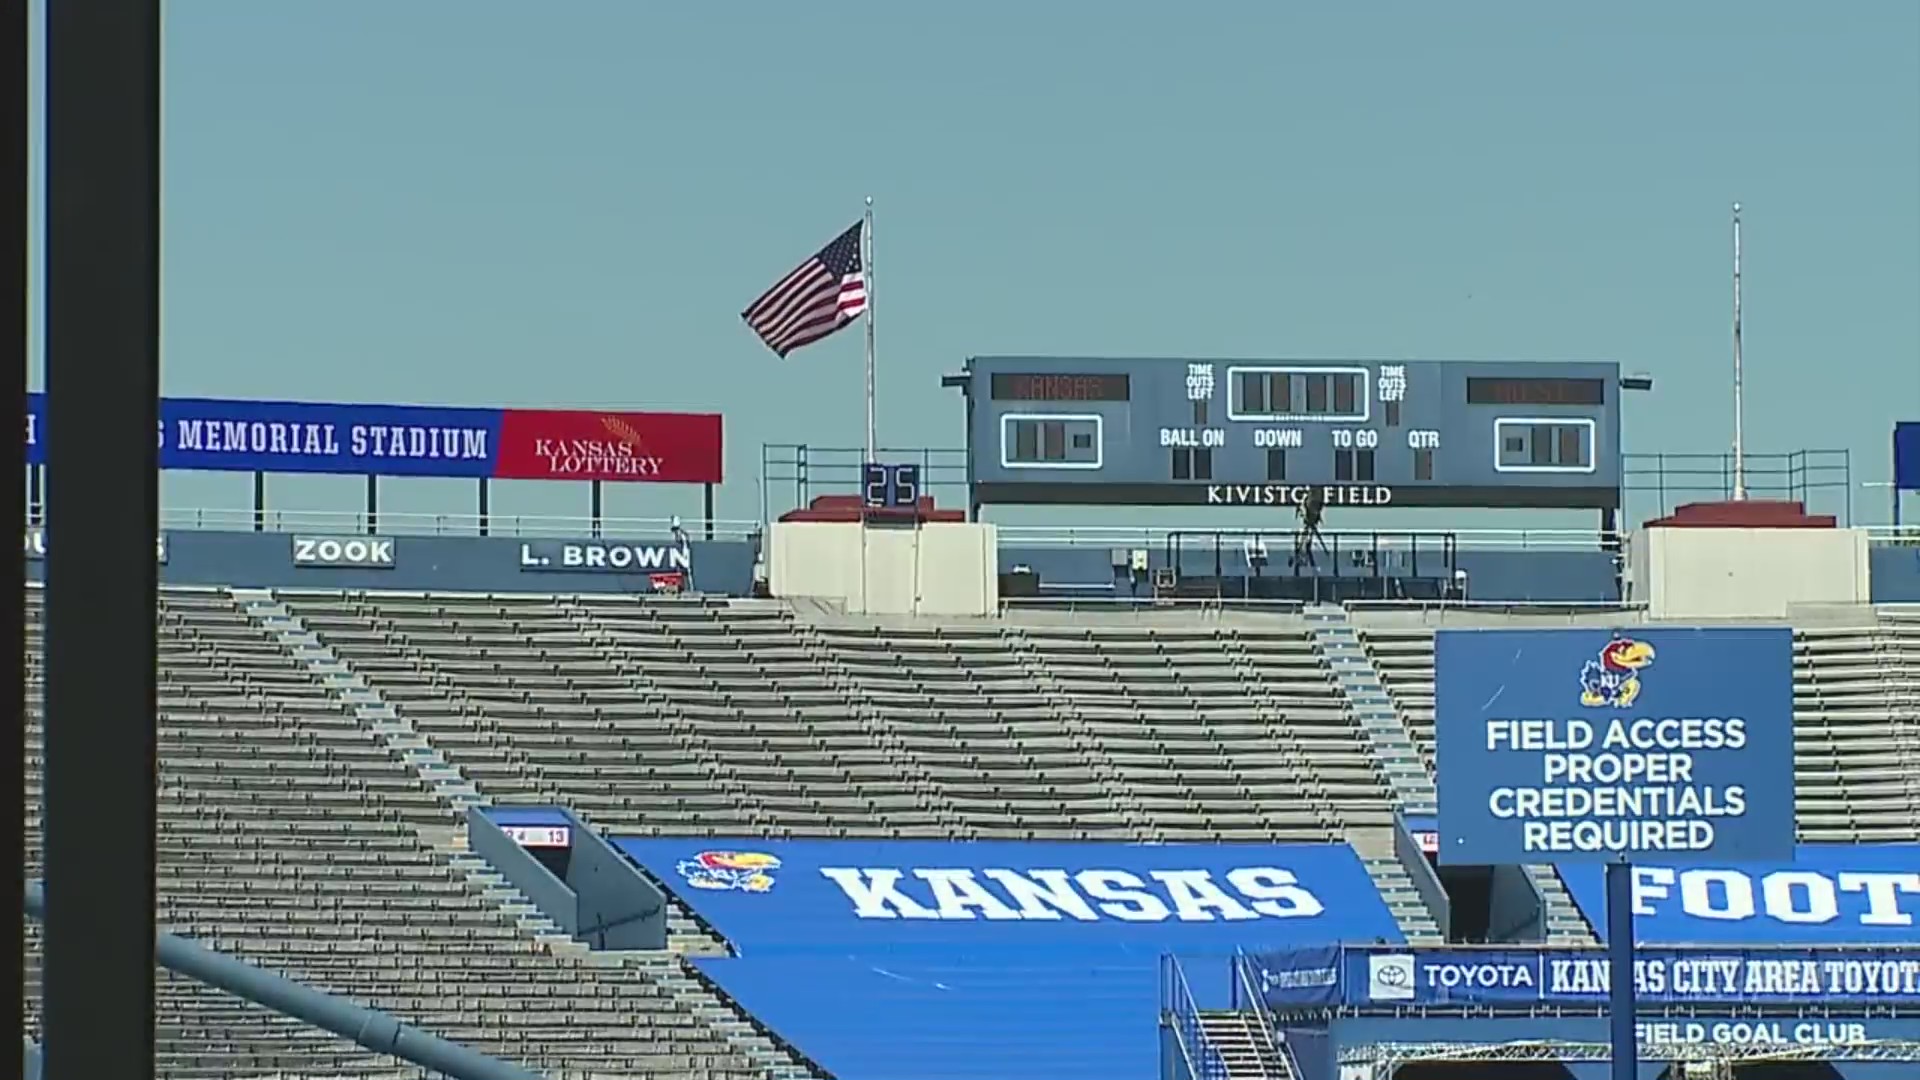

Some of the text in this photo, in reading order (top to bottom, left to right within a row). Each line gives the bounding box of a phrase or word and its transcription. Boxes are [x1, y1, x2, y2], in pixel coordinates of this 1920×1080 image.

[1187, 364, 1213, 376] TIME
[1380, 366, 1405, 377] TIME
[1187, 377, 1215, 387] OUTS
[1378, 378, 1406, 389] OUTS
[1188, 388, 1213, 399] LEFT
[1380, 390, 1404, 401] LEFT
[178, 420, 339, 455] MEMORIAL
[352, 426, 488, 459] STADIUM
[535, 439, 633, 457] KANSAS
[1160, 429, 1224, 447] BALL ON
[1255, 430, 1302, 447] DOWN
[1332, 430, 1378, 448] TO GO
[1408, 431, 1440, 449] QTR
[549, 456, 664, 475] LOTTERY
[867, 467, 916, 503] 25
[1324, 486, 1392, 504] FIELD
[295, 540, 392, 562] ZOOK
[521, 544, 689, 569] L. BROWN
[1487, 719, 1746, 750] FIELD ACCESS
[1545, 754, 1692, 783] PROPER
[1489, 787, 1745, 818] CREDENTIALS
[1524, 821, 1714, 852] REQUIRED
[823, 867, 1323, 921] KANSAS
[1632, 866, 1920, 925] FOOT
[1424, 964, 1533, 987] TOYOTA
[1551, 960, 1920, 993] KANAS CITY AREA TOYOT
[1712, 1023, 1788, 1044] GOAL
[1794, 1023, 1866, 1044] CLUB
